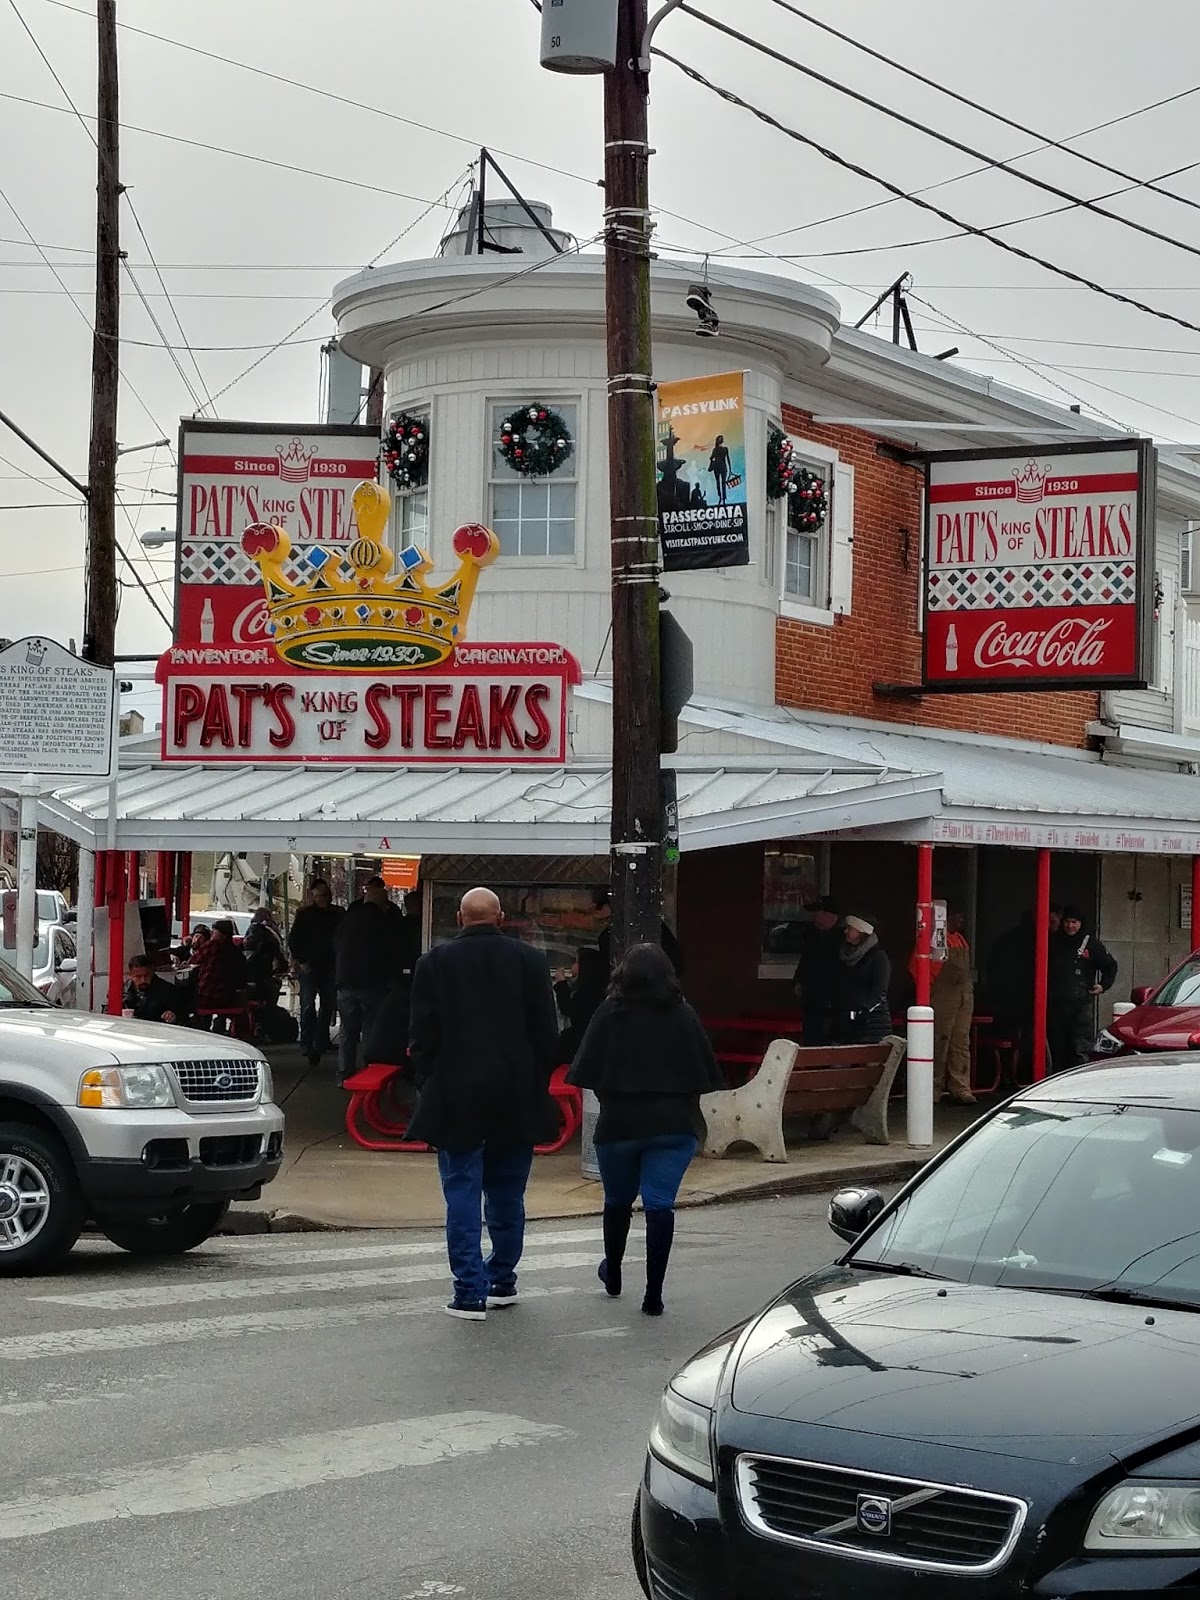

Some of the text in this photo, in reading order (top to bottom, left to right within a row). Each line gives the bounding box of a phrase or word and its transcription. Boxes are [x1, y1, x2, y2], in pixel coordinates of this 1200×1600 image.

[551, 36, 561, 48] 50
[234, 460, 346, 474] Since 1930
[975, 480, 1079, 497] Since 1930
[188, 484, 259, 537] PAT'S
[262, 500, 295, 513] KING
[662, 505, 743, 524] PASSEGGIATA
[935, 503, 1132, 564] PAT'S KING OF STEAKS
[973, 617, 1114, 669] Coca-Cola
[169, 647, 564, 664] INVENTOR ORIGINATOR
[302, 642, 422, 664] Since 1930
[10, 665, 35, 674] KING
[38, 666, 52, 675] OF
[174, 682, 552, 750] PAT'S KING OF STEAKS
[378, 837, 392, 849] A
[861, 1511, 886, 1521] VOLVO
